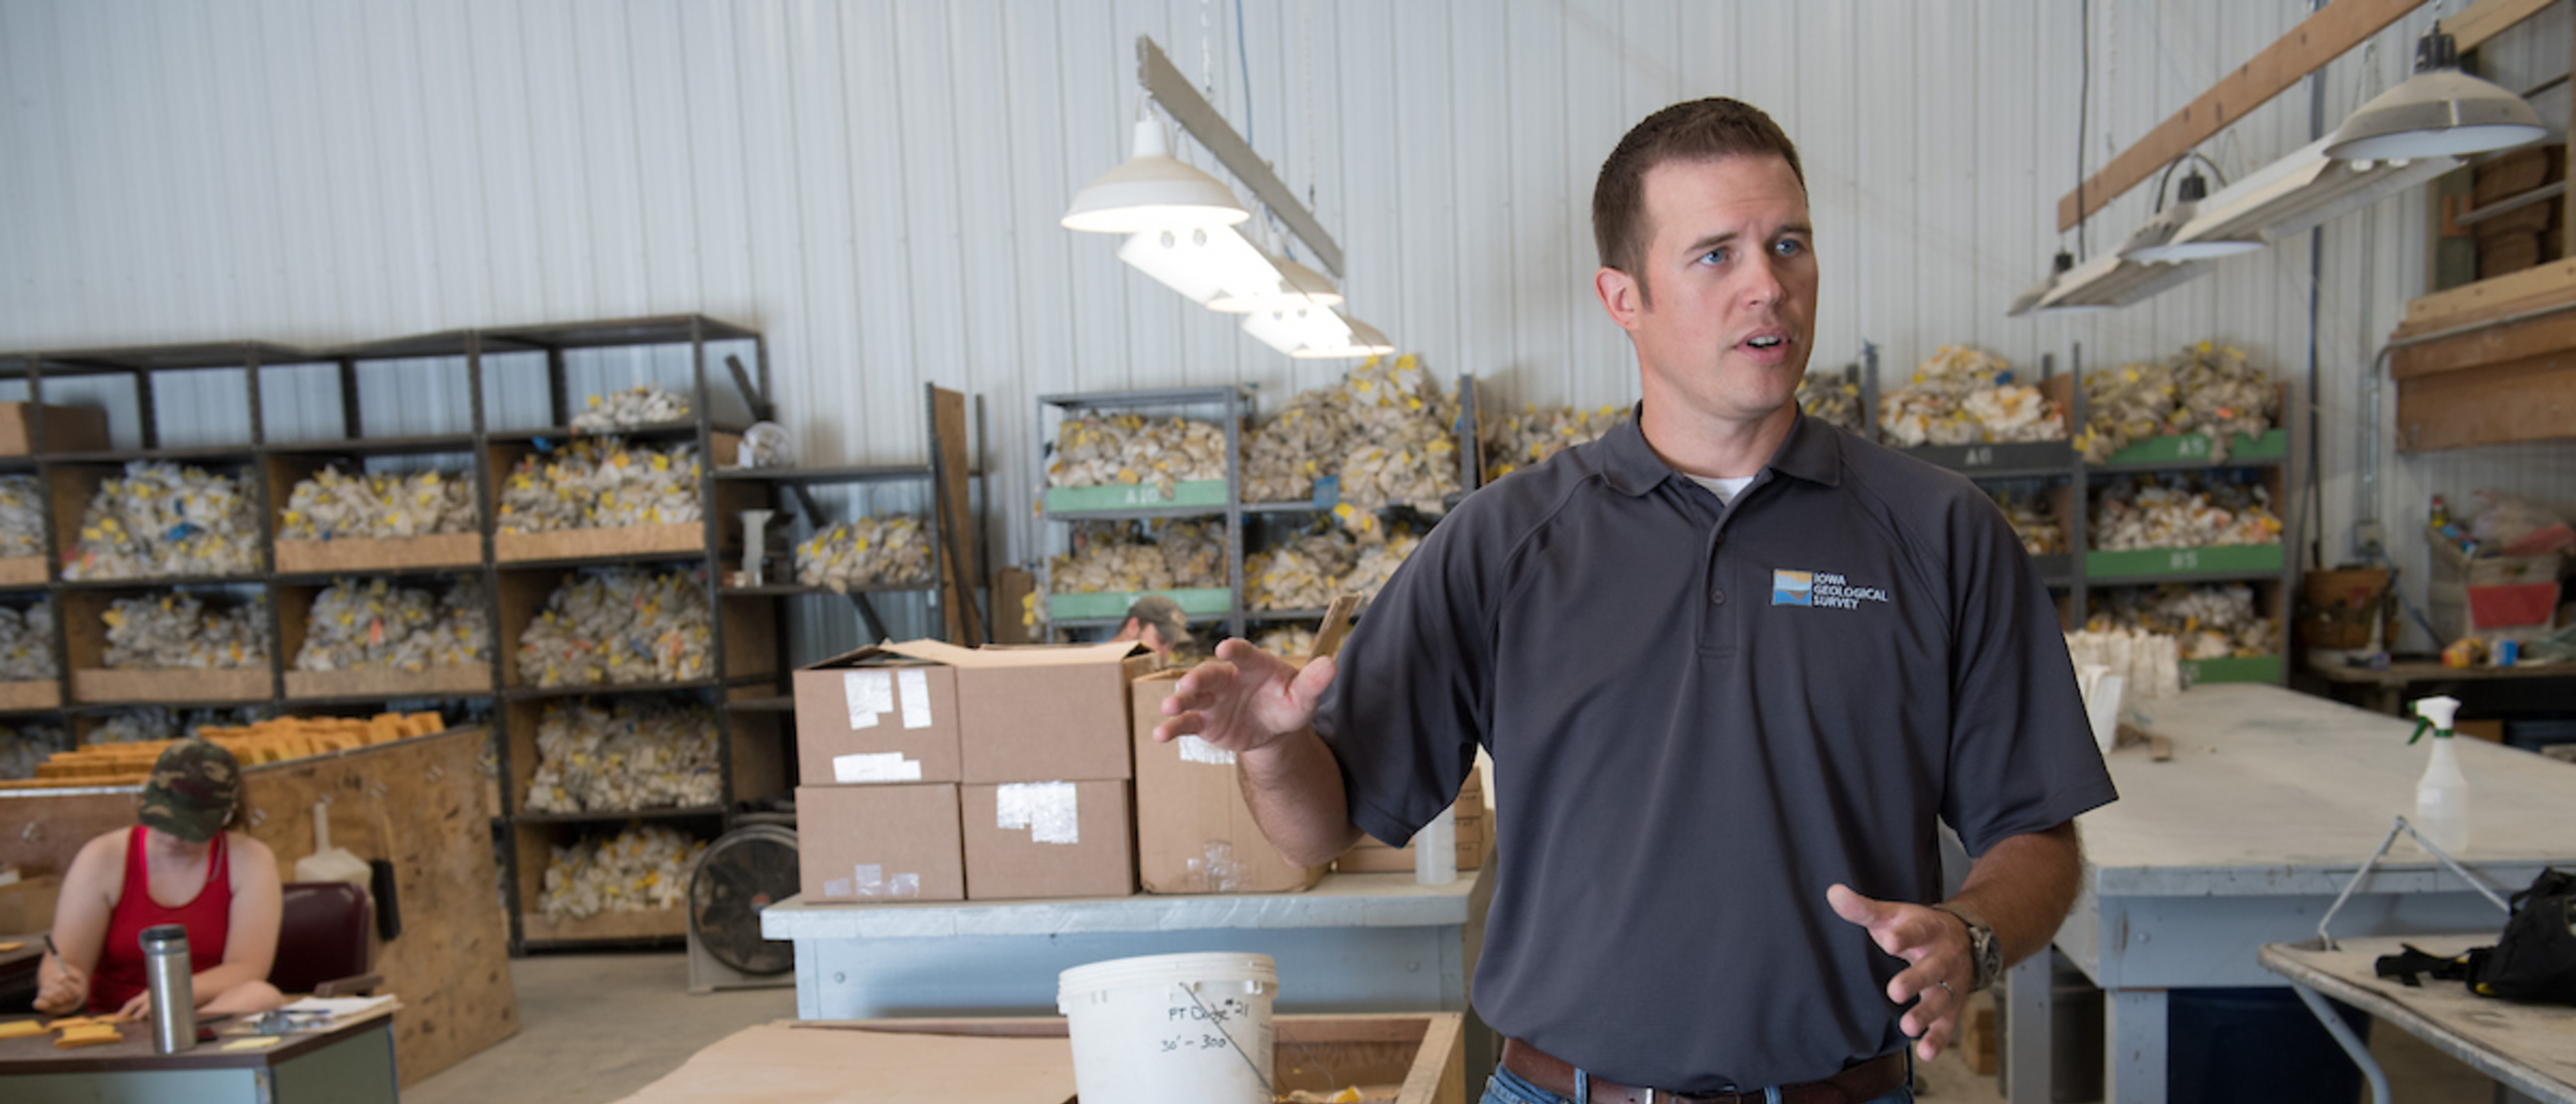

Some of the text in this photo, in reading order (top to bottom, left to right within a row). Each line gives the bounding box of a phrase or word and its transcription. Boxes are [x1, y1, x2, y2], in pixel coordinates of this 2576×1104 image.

[1125, 488, 1160, 504] A10
[1814, 573, 1847, 585] IOWA
[1814, 584, 1888, 602] GEOLOGICAL
[1814, 595, 1858, 610] SURVEY
